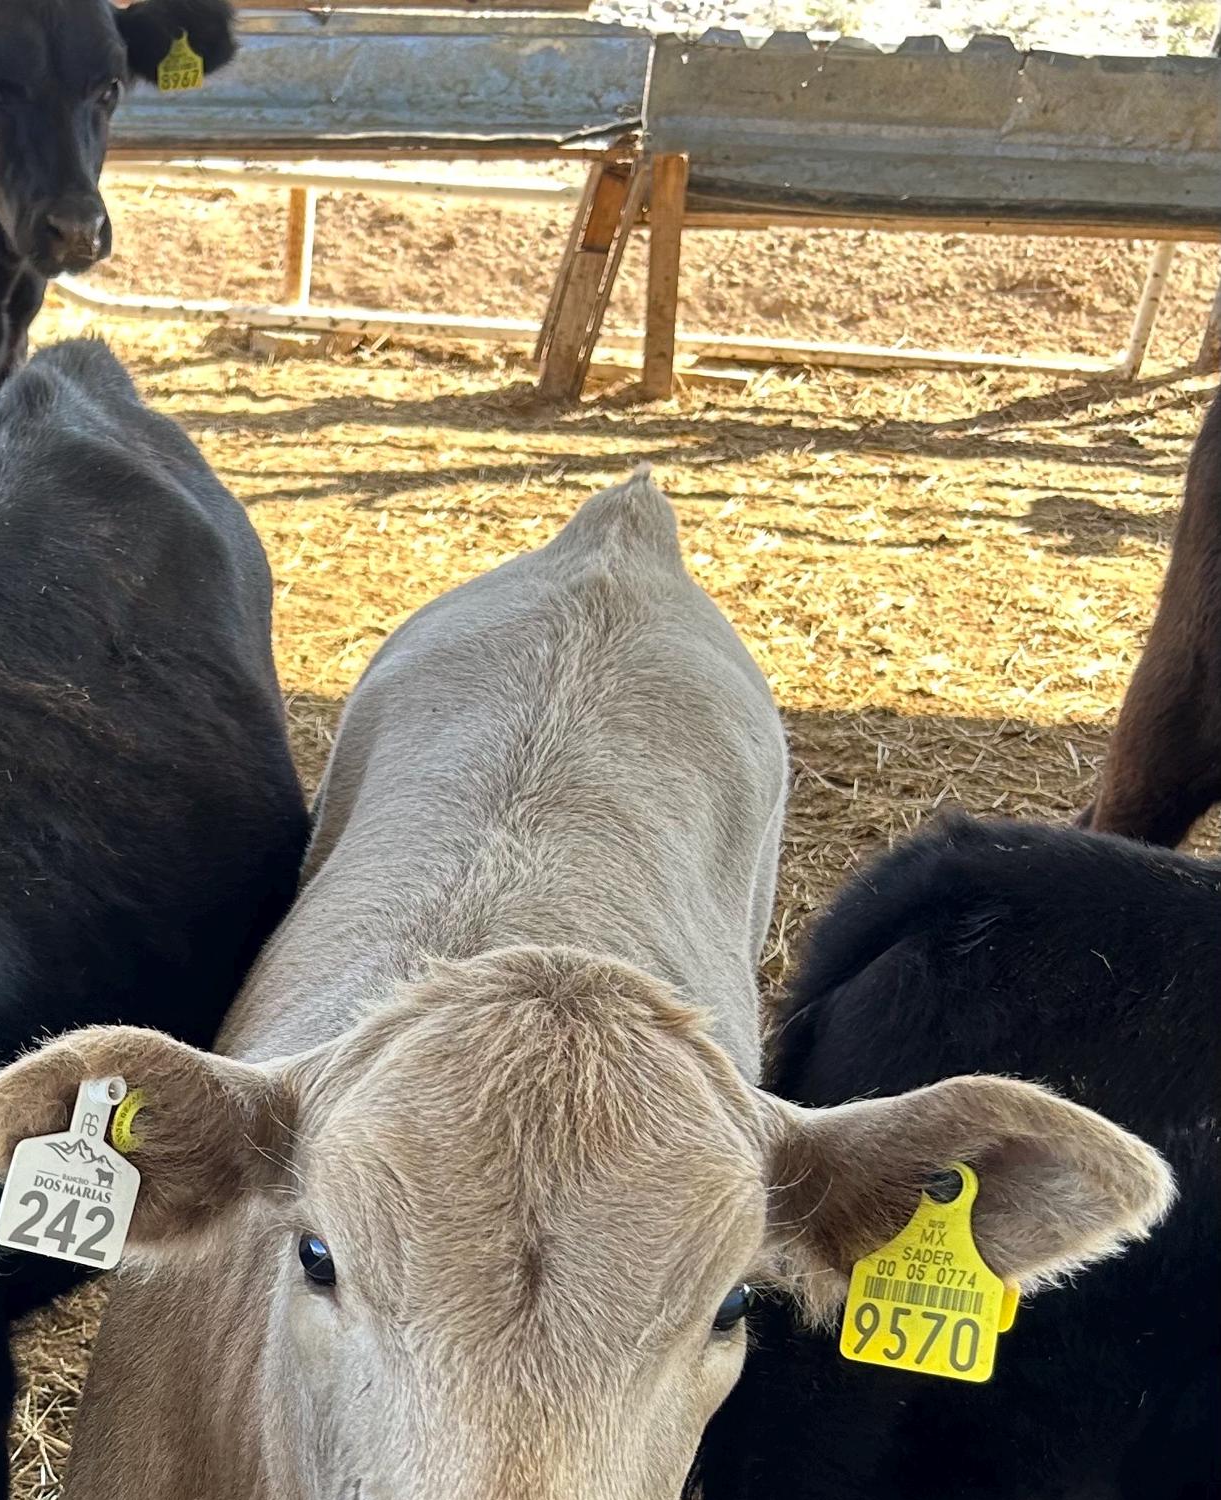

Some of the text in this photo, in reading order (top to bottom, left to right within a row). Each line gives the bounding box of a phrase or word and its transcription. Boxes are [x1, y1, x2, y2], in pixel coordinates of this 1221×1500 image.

[34, 1175, 112, 1204] DOS MARIAS
[8, 1190, 115, 1262] 242
[919, 1229, 948, 1246] MX
[902, 1247, 954, 1266] SADER
[878, 1259, 977, 1288] 00 05 0774
[853, 1302, 980, 1372] 9570
